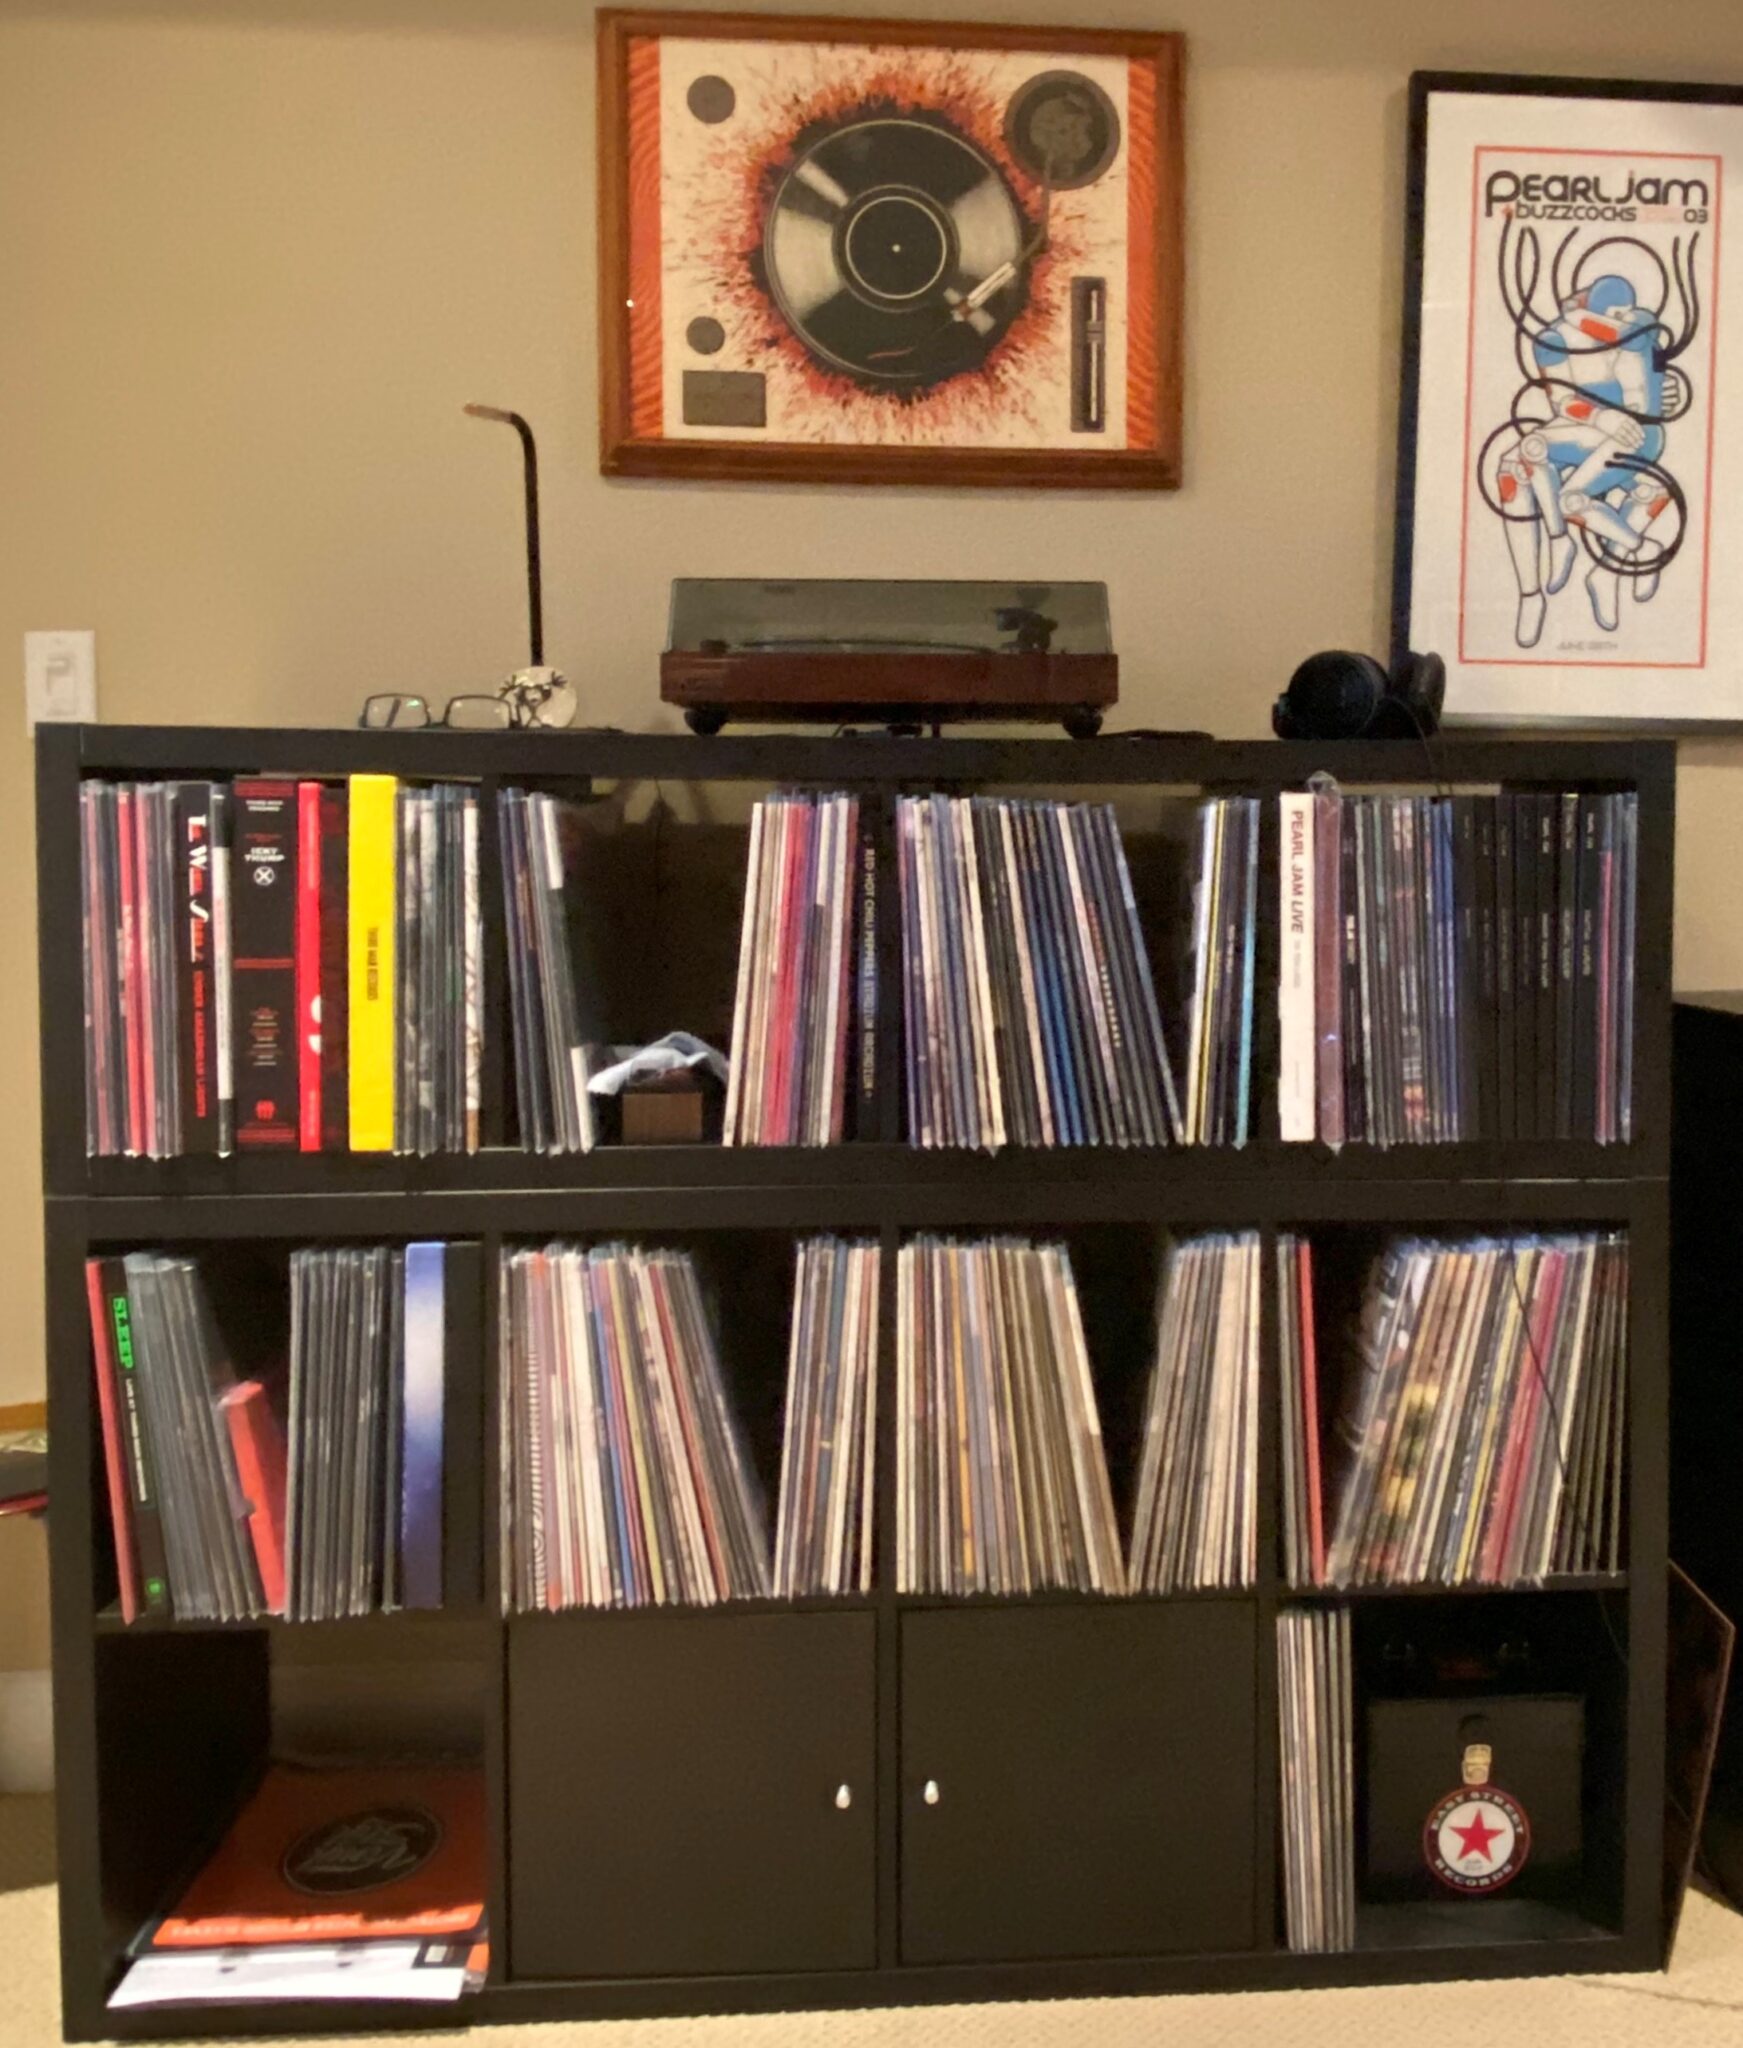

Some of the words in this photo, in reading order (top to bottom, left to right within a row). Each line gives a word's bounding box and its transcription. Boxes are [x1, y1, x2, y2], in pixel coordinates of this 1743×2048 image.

[1292, 810, 1304, 859] PEARL
[864, 848, 875, 870] RED
[864, 872, 875, 897] HOT
[1292, 863, 1304, 896] JAM
[864, 898, 875, 928] CHILI
[1292, 900, 1304, 934] LIVE
[864, 930, 875, 977] PEPPERS
[113, 1297, 134, 1369] SLEEP
[1470, 1791, 1525, 1834] STREET
[1434, 1857, 1514, 1887] RECORDS
